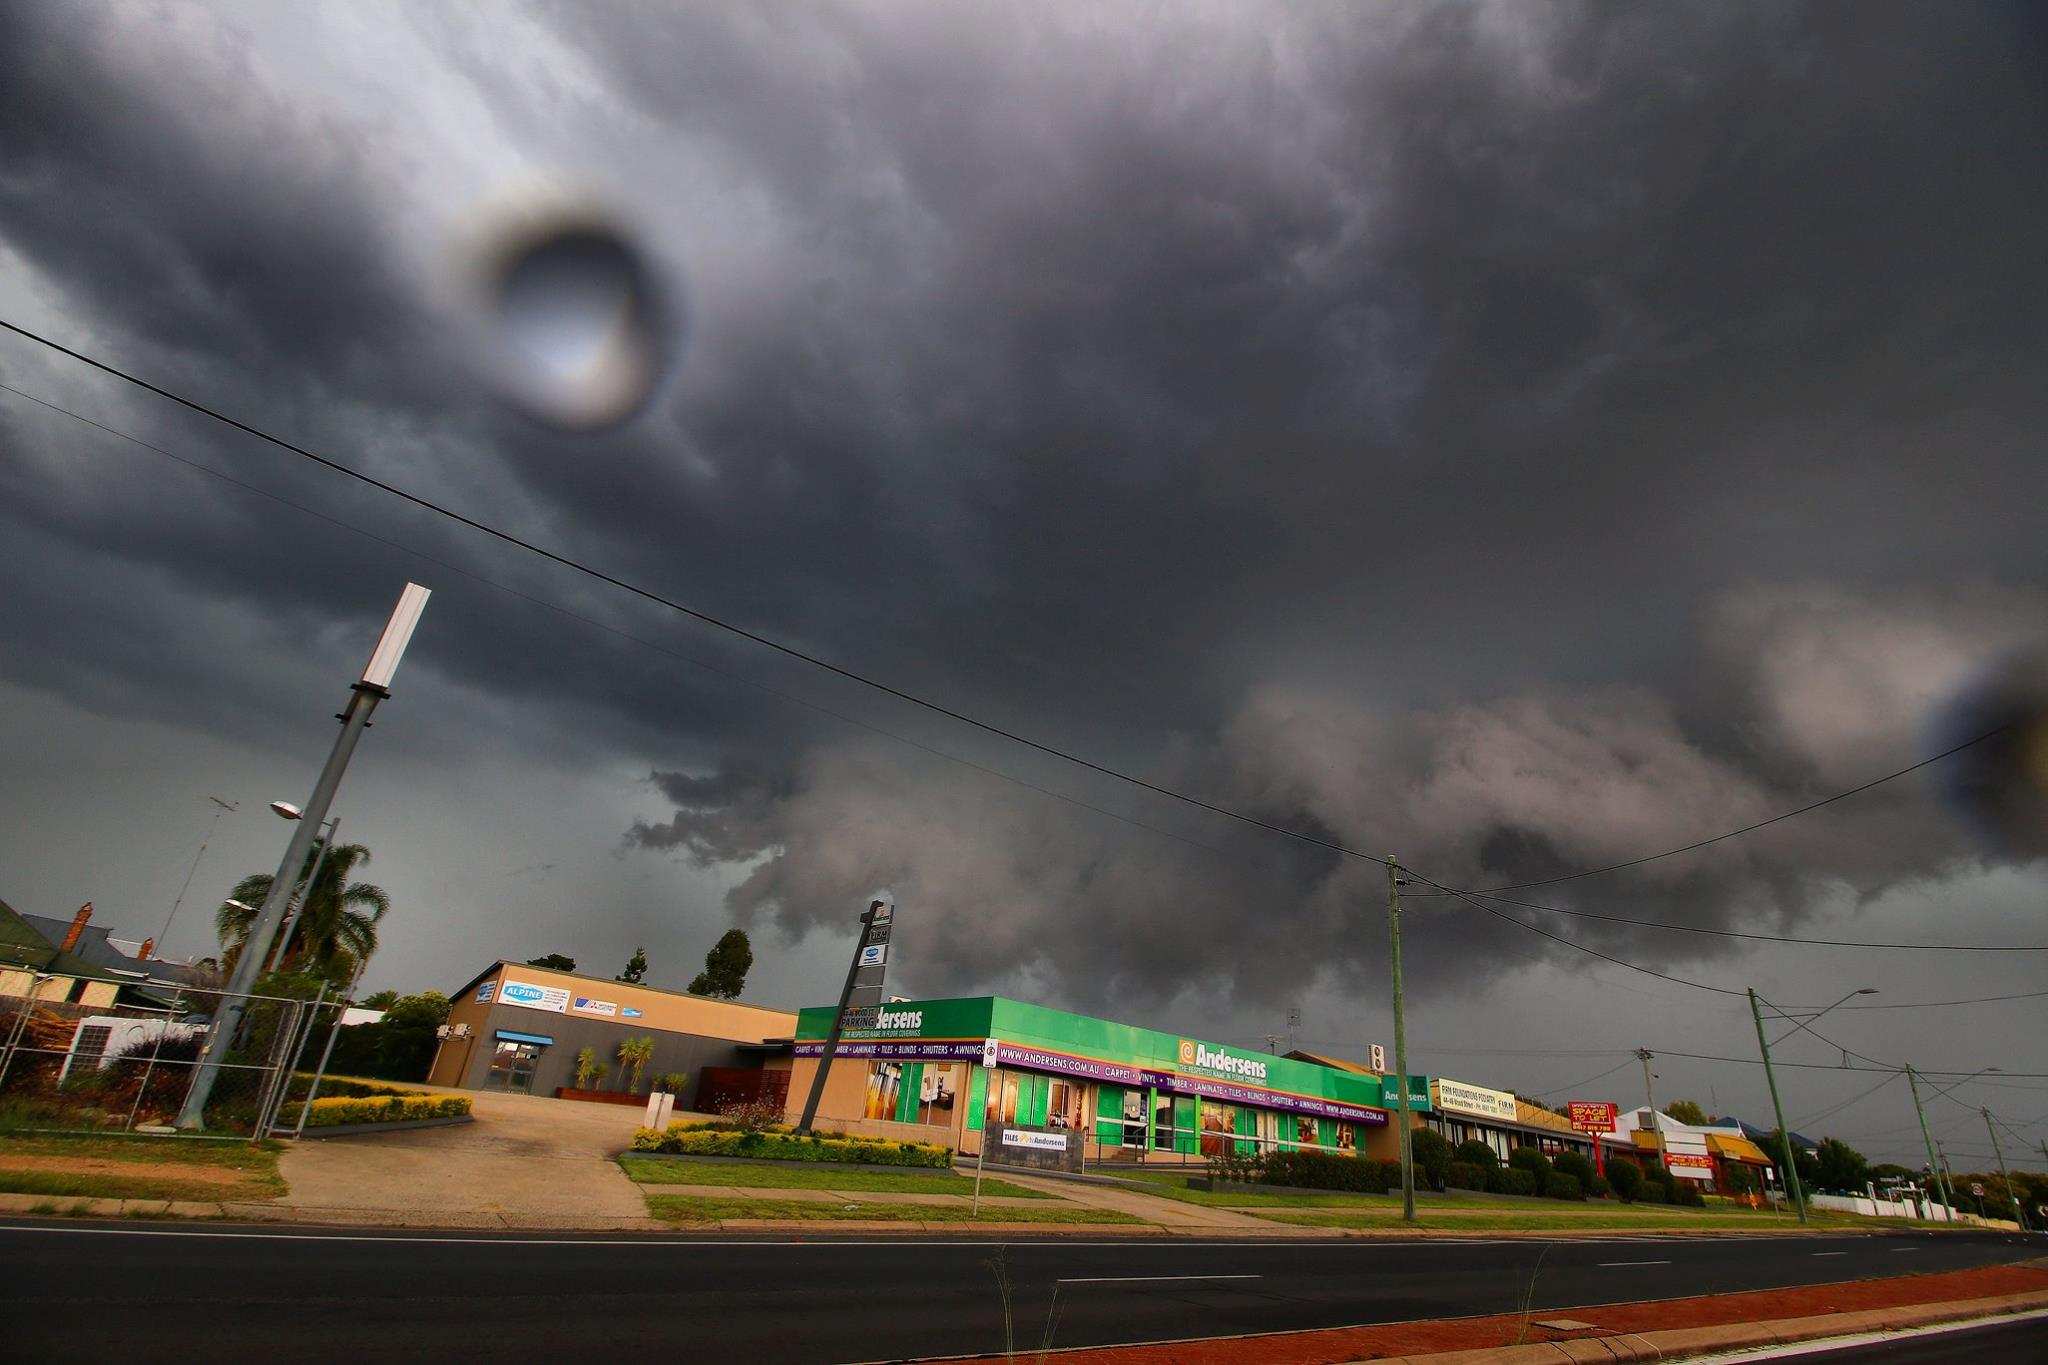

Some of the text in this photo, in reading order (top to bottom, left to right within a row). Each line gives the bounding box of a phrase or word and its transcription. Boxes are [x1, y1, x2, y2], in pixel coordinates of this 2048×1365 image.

[506, 987, 542, 999] ALPINE
[876, 1007, 923, 1029] dersens
[852, 1046, 876, 1054] LAMINATE
[881, 1045, 893, 1054] TILES
[899, 1045, 917, 1054] BLINDS
[922, 1045, 948, 1054] SHUTTERS
[954, 1045, 985, 1055] AWNINGS
[1196, 1043, 1267, 1078] Andersens
[1105, 1068, 1130, 1079] CARPET
[1137, 1073, 1156, 1084] VINYL
[1167, 1077, 1187, 1088] TIMBER
[1195, 1082, 1223, 1095] LAMINATE
[1229, 1088, 1242, 1097] TILES
[1572, 1108, 1607, 1116] SPACE
[1035, 1136, 1065, 1147] Andersens
